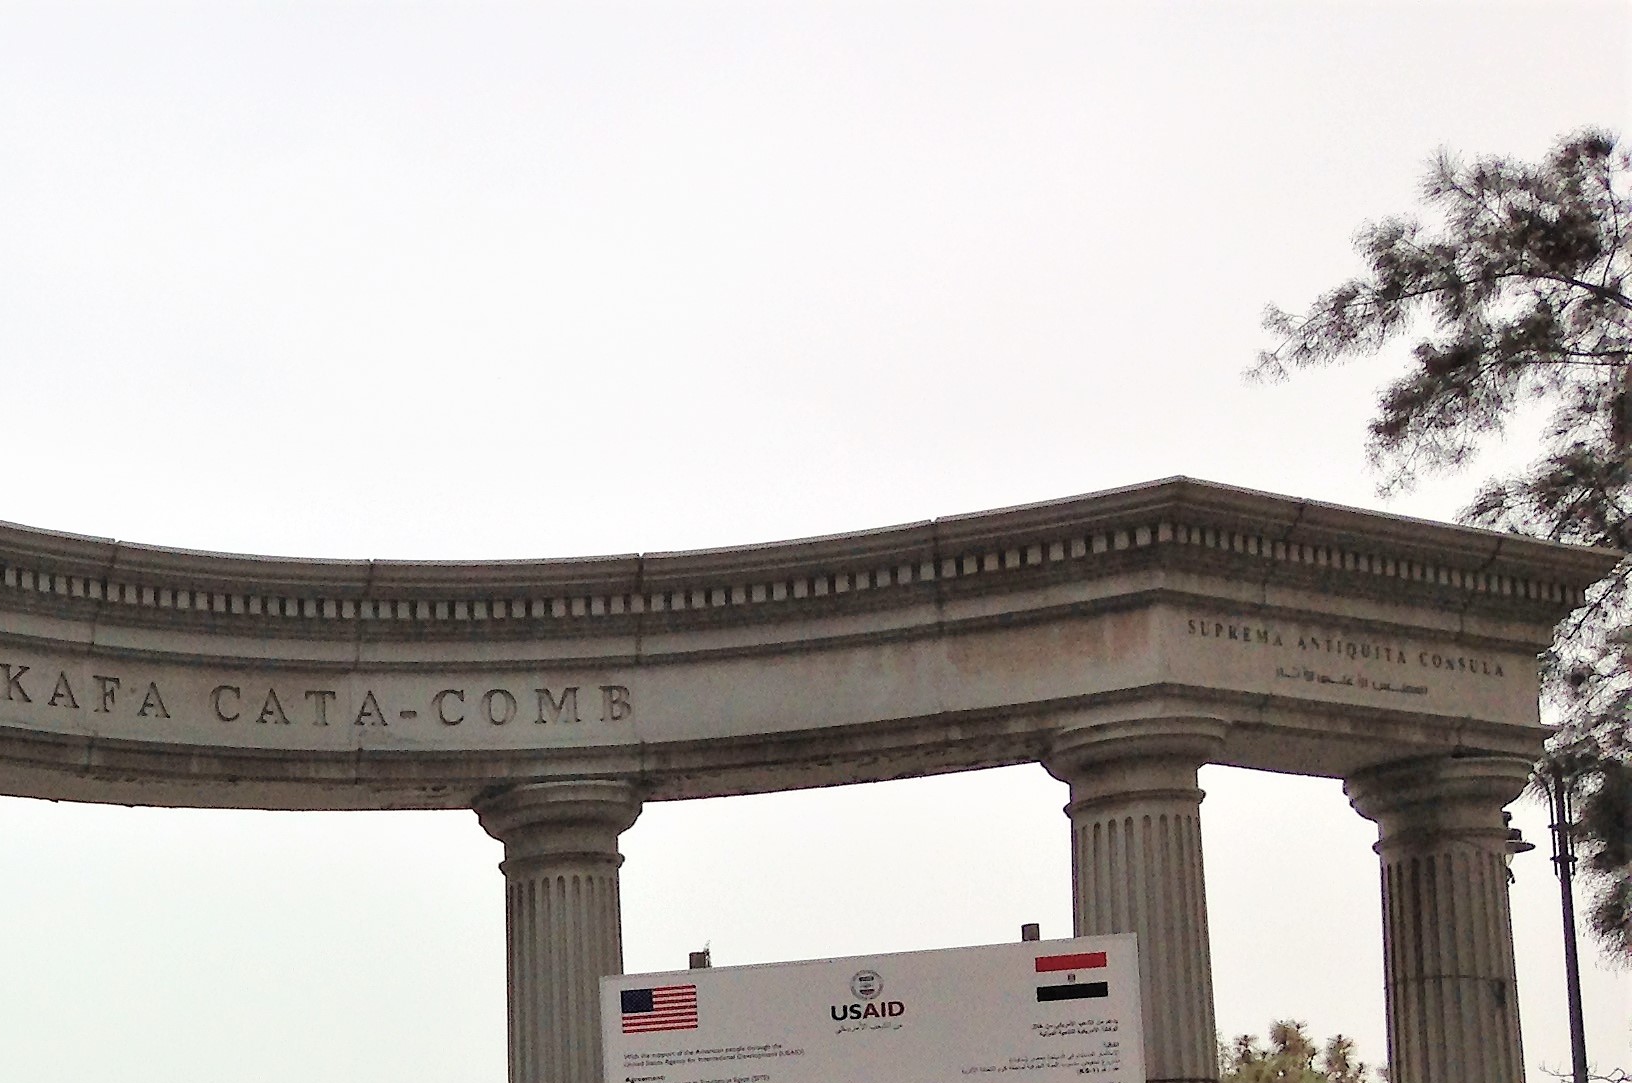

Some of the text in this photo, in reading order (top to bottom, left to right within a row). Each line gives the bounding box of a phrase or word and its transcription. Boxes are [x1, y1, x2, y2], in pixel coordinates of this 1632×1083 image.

[1187, 618, 1283, 647] SUPREMA
[1419, 651, 1504, 677] CONSULA
[209, 685, 632, 727] CATA-COMB
[830, 1001, 905, 1021] USAID
